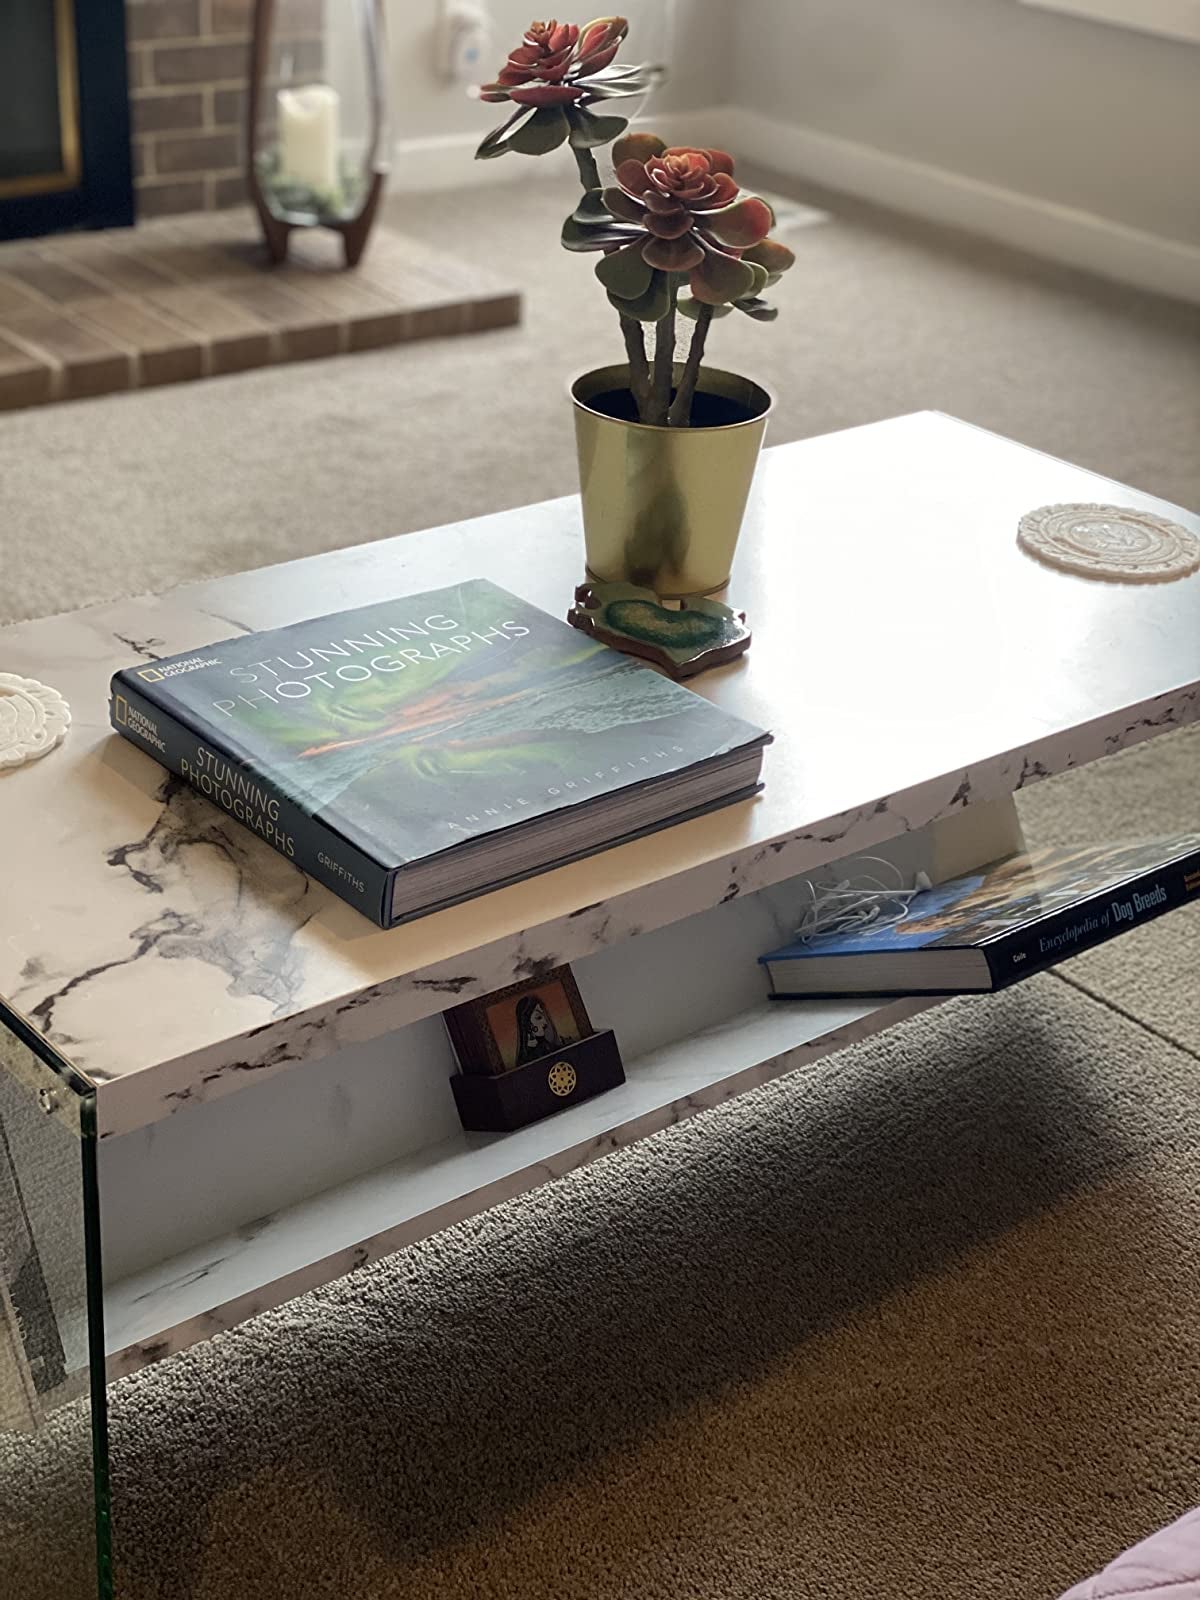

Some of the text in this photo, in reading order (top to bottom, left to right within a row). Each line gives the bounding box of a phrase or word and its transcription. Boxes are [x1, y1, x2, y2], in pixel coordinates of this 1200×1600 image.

[158, 657, 206, 673] NATIONAL
[163, 659, 222, 678] GEOGRAPHIC
[212, 620, 530, 717] PHOTOGRAPHS
[230, 614, 459, 684] STUNNING
[127, 717, 166, 753] GEOGRAPHIC
[128, 706, 158, 736] NATIONAL
[181, 758, 295, 858] PHOTOGRAPHS
[196, 746, 281, 822] STUNNING
[447, 745, 684, 830] ANNIE GRIFFITHS
[317, 852, 366, 894] GRIFFITHS
[1039, 915, 1099, 953] Encyclopedia
[1101, 911, 1111, 928] of
[1111, 901, 1135, 922] Dog
[1132, 884, 1167, 912] Breeds
